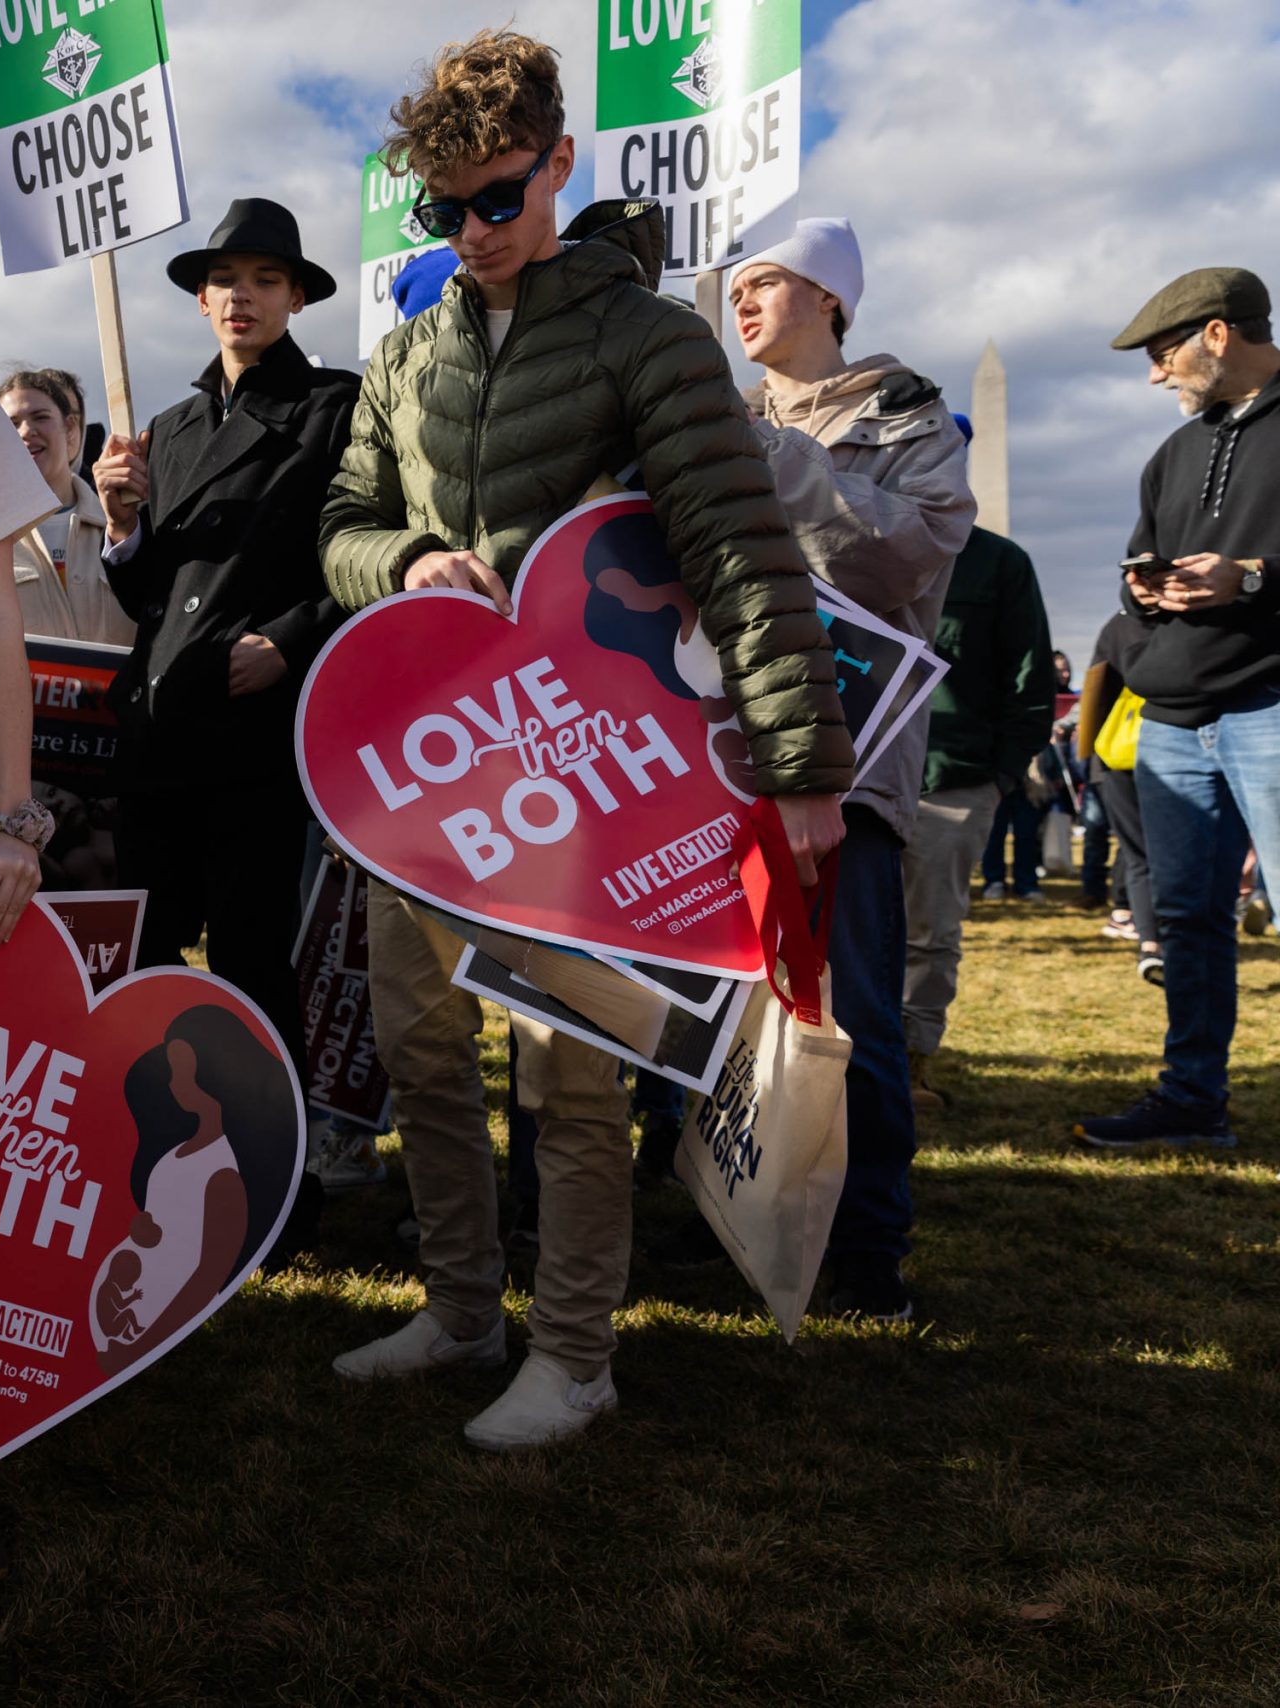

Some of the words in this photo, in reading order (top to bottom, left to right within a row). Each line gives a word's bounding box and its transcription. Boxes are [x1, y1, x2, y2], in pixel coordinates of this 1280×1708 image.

[12, 83, 153, 194] CHOOSE
[621, 90, 780, 198] CHOOSE
[56, 173, 131, 258] LIFE
[664, 186, 744, 270] LIFE
[28, 672, 82, 710] TER
[31, 733, 64, 752] ere
[70, 732, 89, 755] is
[95, 736, 118, 759] Li
[357, 656, 584, 812] LOVE
[471, 709, 627, 779] them
[439, 713, 691, 883] BOTH
[601, 853, 671, 909] LIVE
[663, 815, 741, 875] ACTION
[631, 911, 662, 933] Text
[658, 883, 713, 919] MARCH
[711, 877, 728, 890] to
[681, 889, 746, 928] LiveActionO
[309, 973, 370, 1102] ECTION
[726, 1038, 759, 1090] Life
[696, 1095, 745, 1200] RIGHT
[4, 1362, 18, 1377] to
[19, 1366, 60, 1389] 47581
